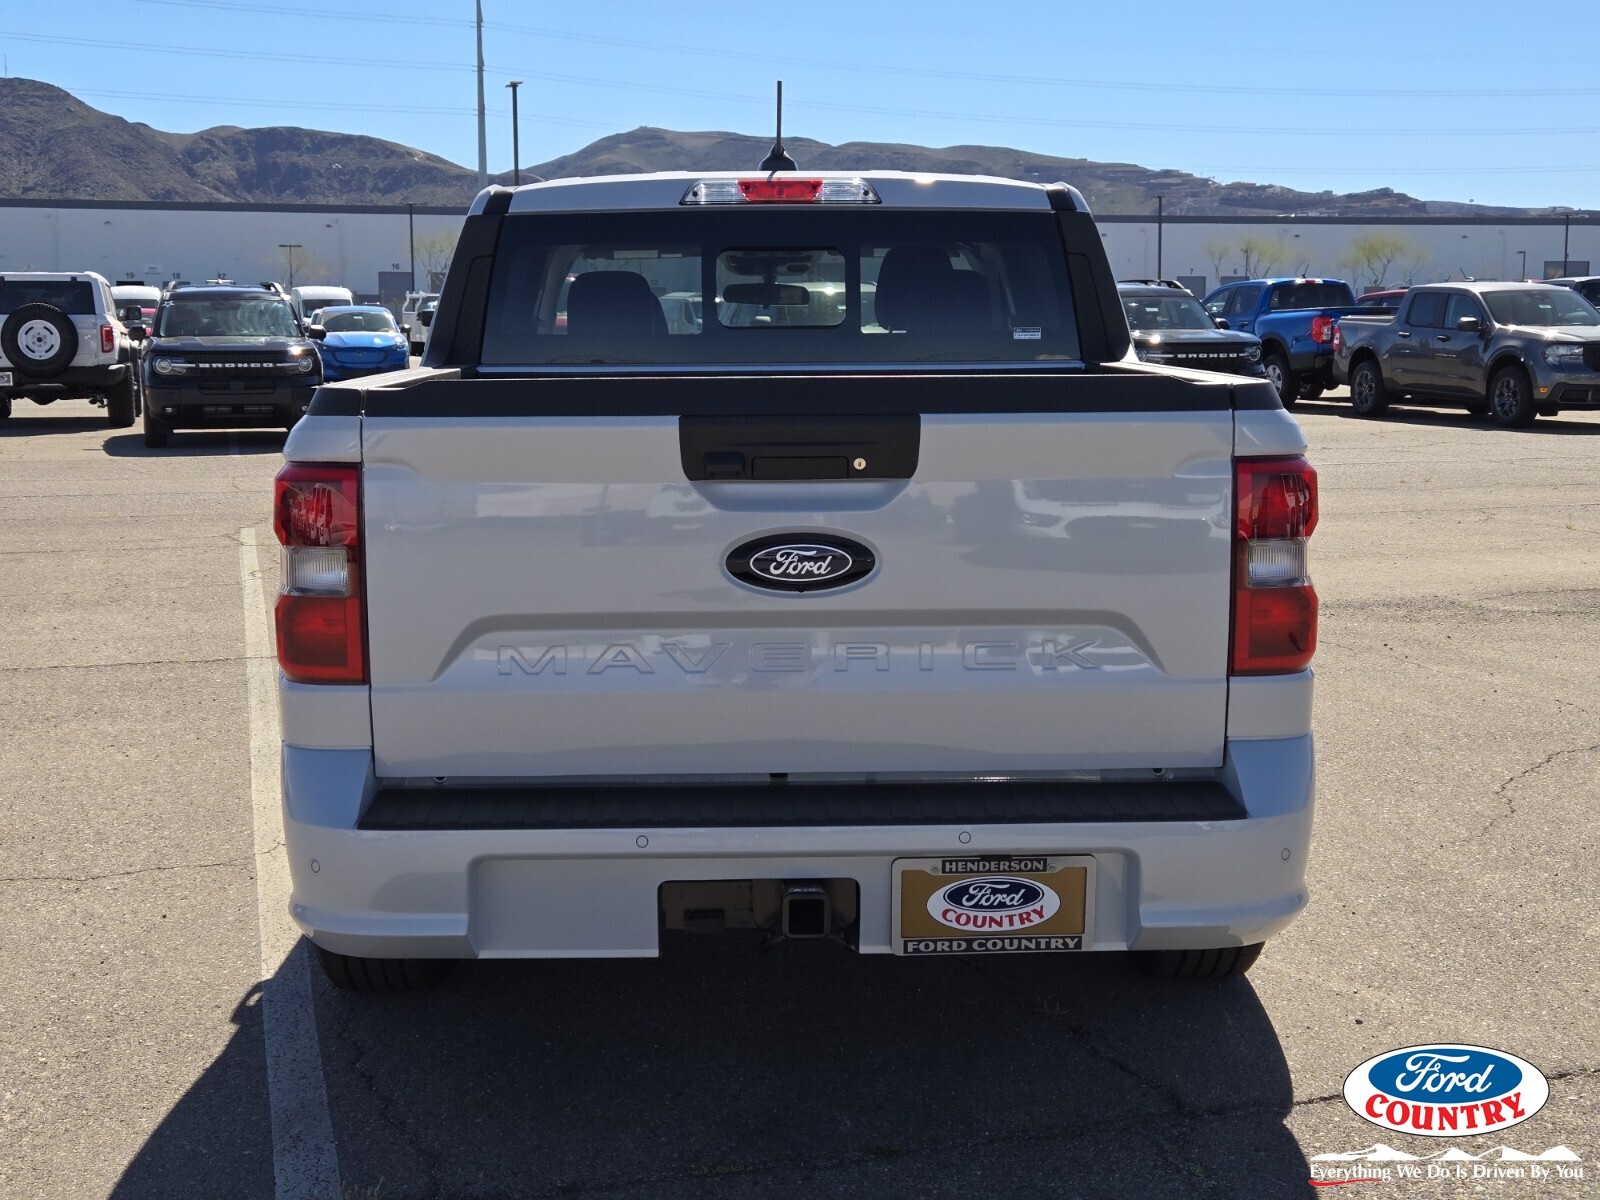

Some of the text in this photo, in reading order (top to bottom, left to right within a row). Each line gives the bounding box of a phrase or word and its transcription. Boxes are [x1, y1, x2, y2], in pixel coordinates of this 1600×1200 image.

[391, 262, 400, 270] 16
[126, 272, 135, 280] 19
[172, 272, 181, 280] 18
[769, 549, 833, 575] Ford
[496, 639, 1100, 676] MAVERICK
[944, 860, 1045, 872] HENDERSON
[961, 883, 1026, 907] Ford
[941, 905, 1045, 928] COUNTRY
[907, 937, 1080, 952] FORD COUNTRY
